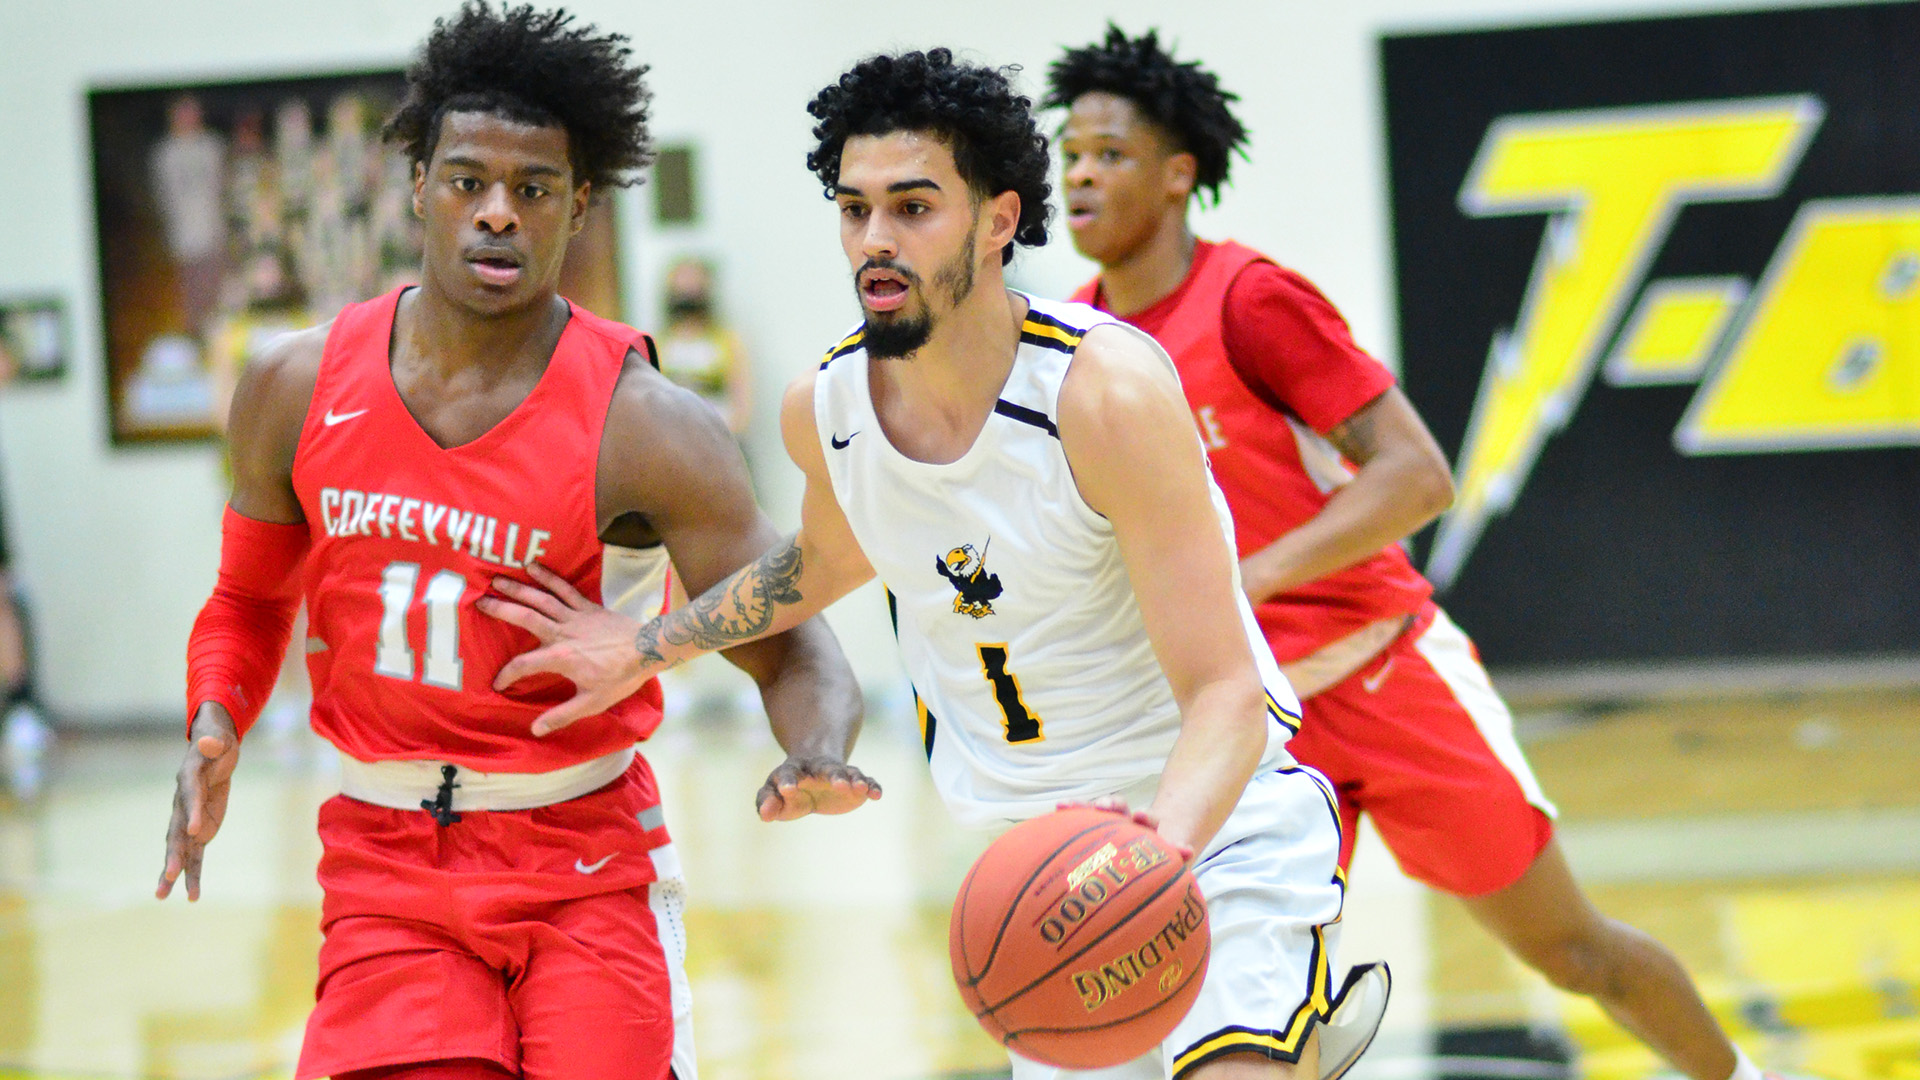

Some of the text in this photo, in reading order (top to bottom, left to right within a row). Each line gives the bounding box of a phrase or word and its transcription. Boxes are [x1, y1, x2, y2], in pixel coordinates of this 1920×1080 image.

[1199, 406, 1229, 449] E
[320, 487, 550, 568] COFFEYVILLE
[373, 561, 466, 692] 11
[975, 642, 1046, 746] 1
[1039, 837, 1168, 944] TF-1000
[1071, 883, 1205, 1012] SPALDING
